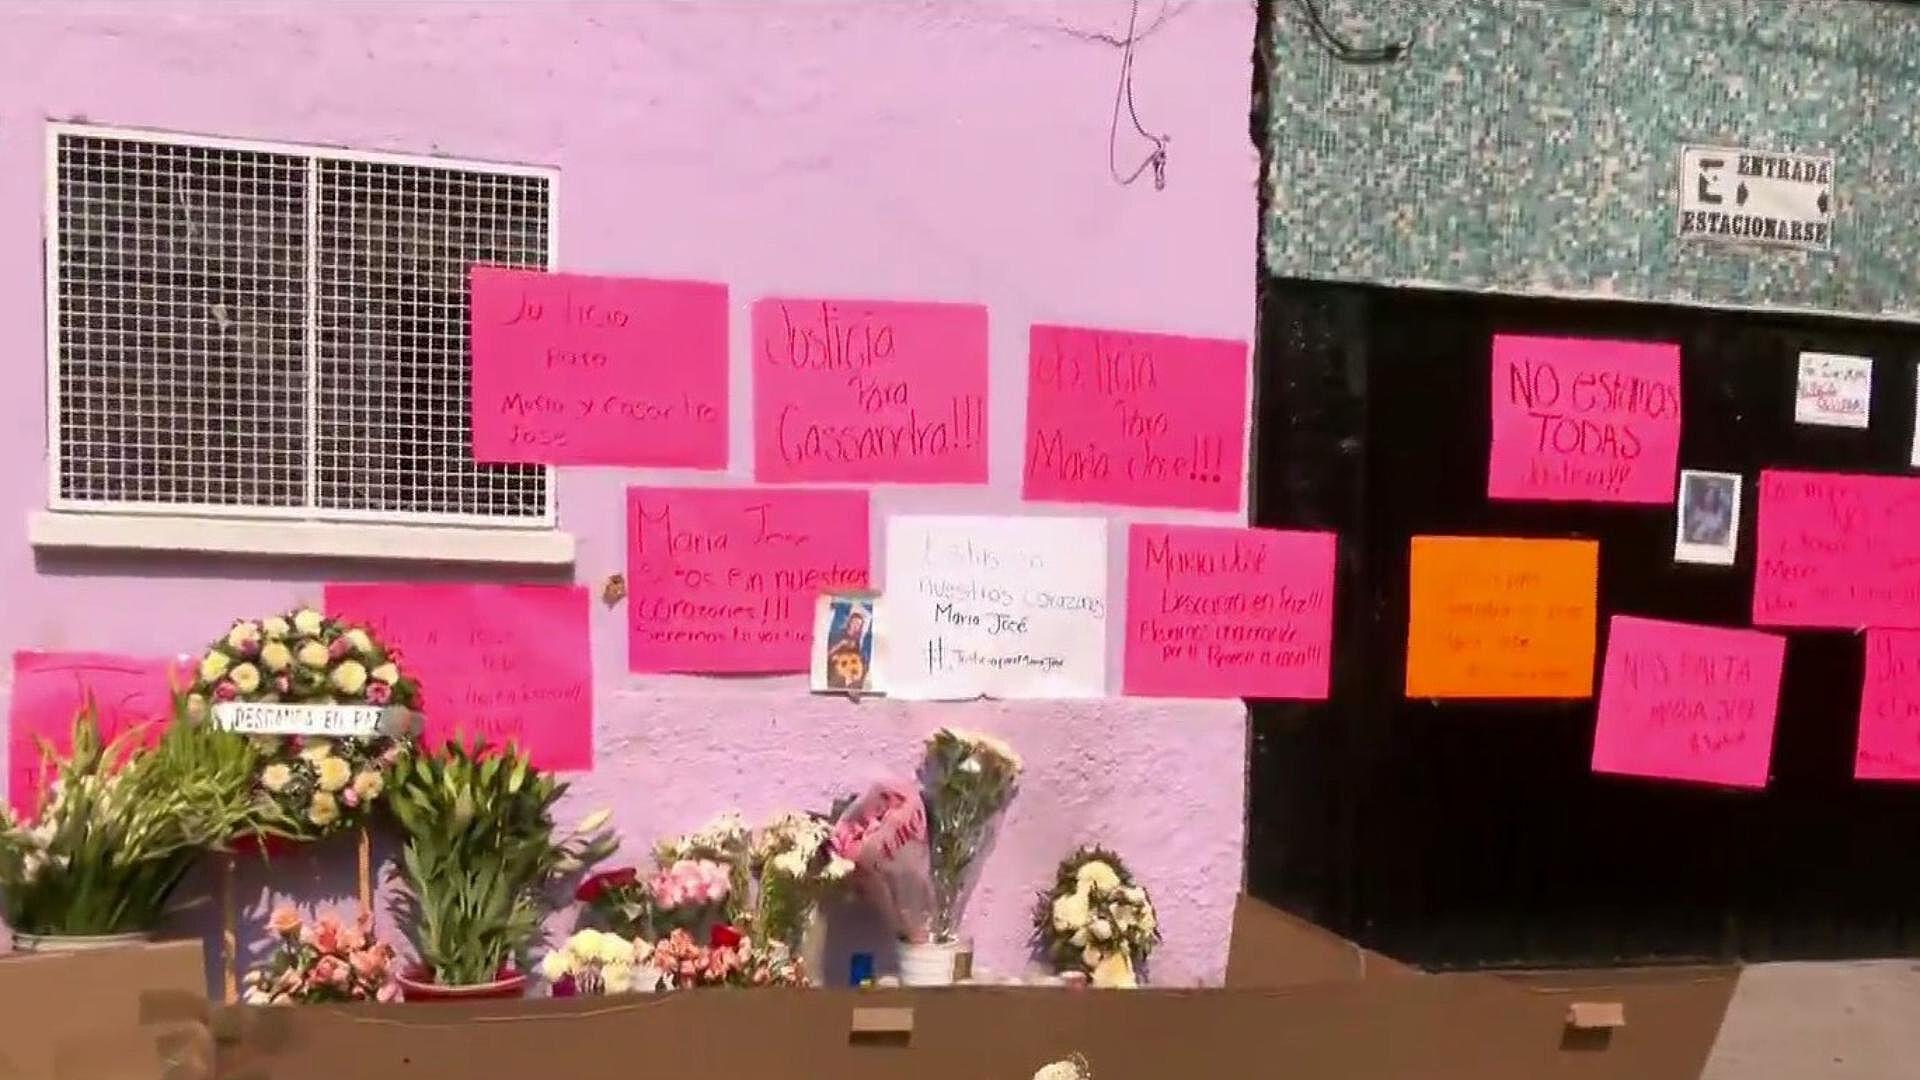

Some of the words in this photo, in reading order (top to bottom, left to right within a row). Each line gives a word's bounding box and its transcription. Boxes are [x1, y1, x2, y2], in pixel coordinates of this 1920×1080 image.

[1736, 154, 1831, 185] ENTRADA
[1681, 210, 1828, 243] ESTACIONARSE
[1510, 359, 1561, 410] NO
[576, 399, 594, 419] y
[1529, 412, 1642, 460] TODAS
[235, 707, 314, 730] DESCANA
